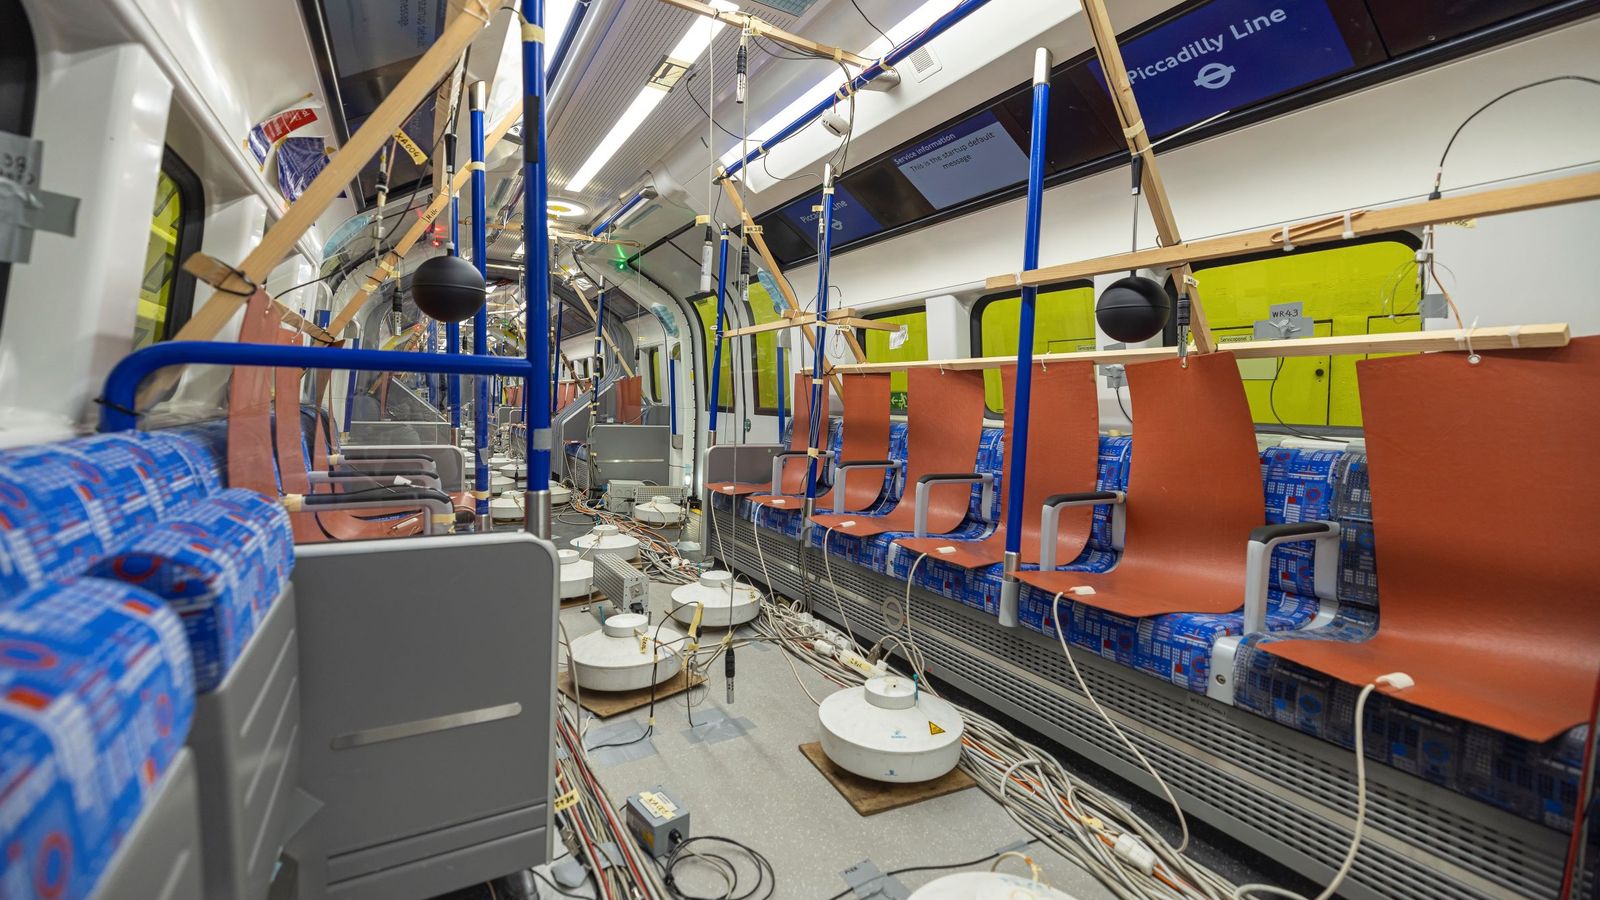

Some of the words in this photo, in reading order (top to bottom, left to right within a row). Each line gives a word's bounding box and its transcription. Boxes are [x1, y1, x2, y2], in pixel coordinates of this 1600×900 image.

[1126, 33, 1224, 84] Piccadilly
[1229, 8, 1287, 40] Line
[894, 150, 917, 165] Service
[916, 133, 956, 155] information
[910, 161, 924, 172] This
[930, 155, 942, 164] the
[942, 144, 968, 159] startup
[967, 132, 996, 148] default
[942, 154, 972, 170] message
[1272, 308, 1299, 318] WR43
